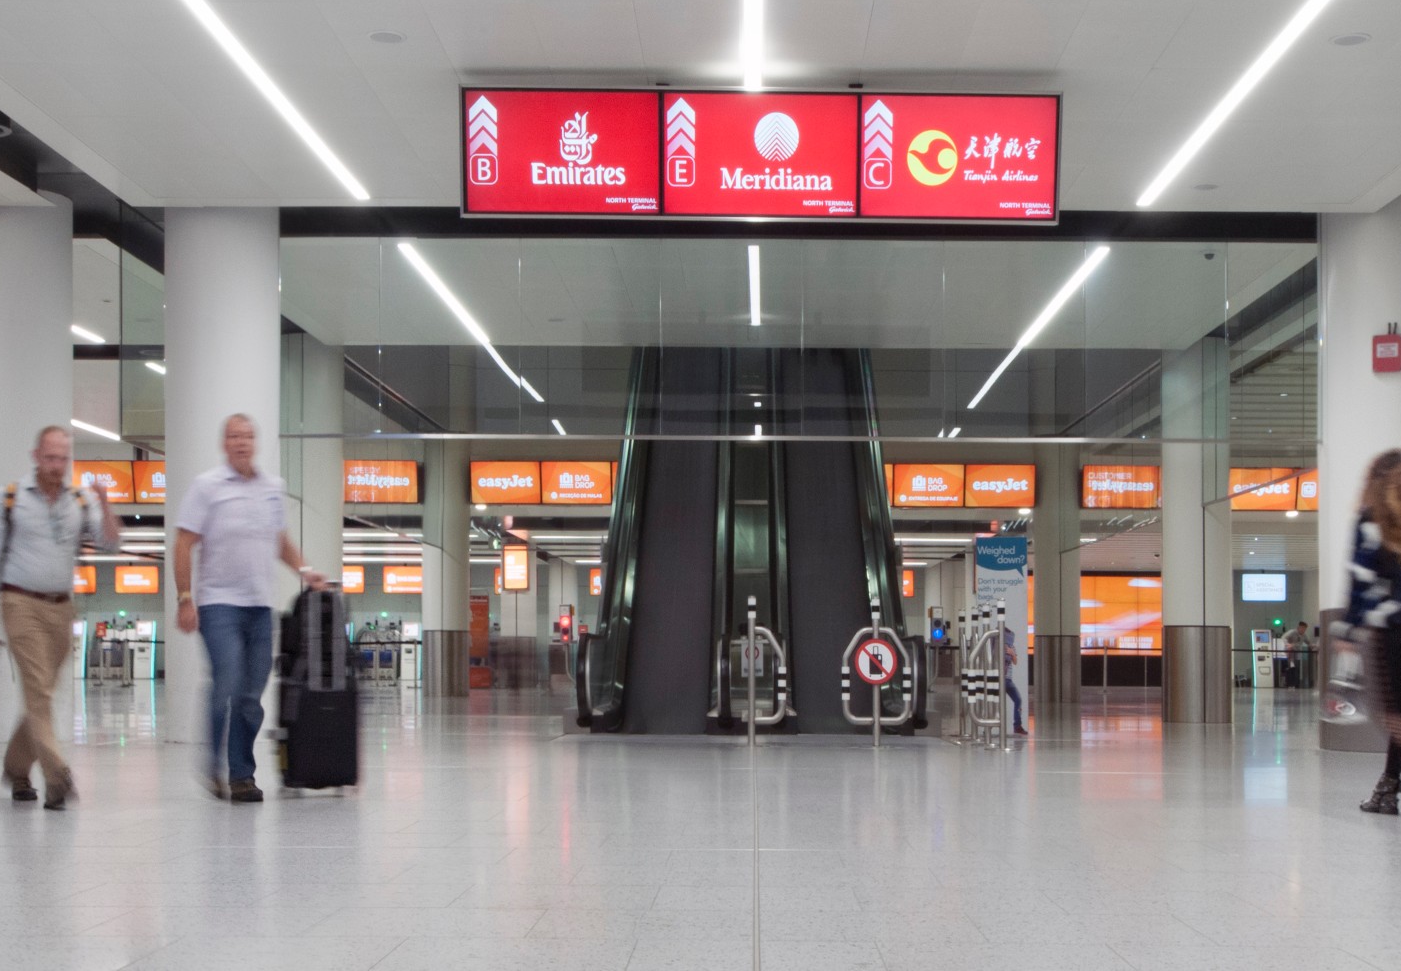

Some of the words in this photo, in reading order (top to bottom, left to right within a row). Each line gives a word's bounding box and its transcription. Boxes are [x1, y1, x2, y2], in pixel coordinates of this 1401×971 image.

[964, 133, 1041, 169] 天津航空
[477, 158, 491, 181] B
[531, 162, 626, 186] Emirates
[675, 160, 688, 183] E
[868, 162, 885, 185] C
[720, 167, 833, 191] Meridiana
[963, 170, 998, 184] Tianjin
[1001, 170, 1039, 182] Airlines
[478, 474, 534, 490] easyJet
[574, 474, 590, 482] BAG
[574, 481, 595, 489] DROP
[927, 477, 943, 485] BAG
[927, 484, 948, 492] DROP
[972, 478, 1029, 493] easyJet
[977, 546, 1016, 557] Weighed
[997, 555, 1025, 564] down?
[997, 578, 1023, 586] struggle
